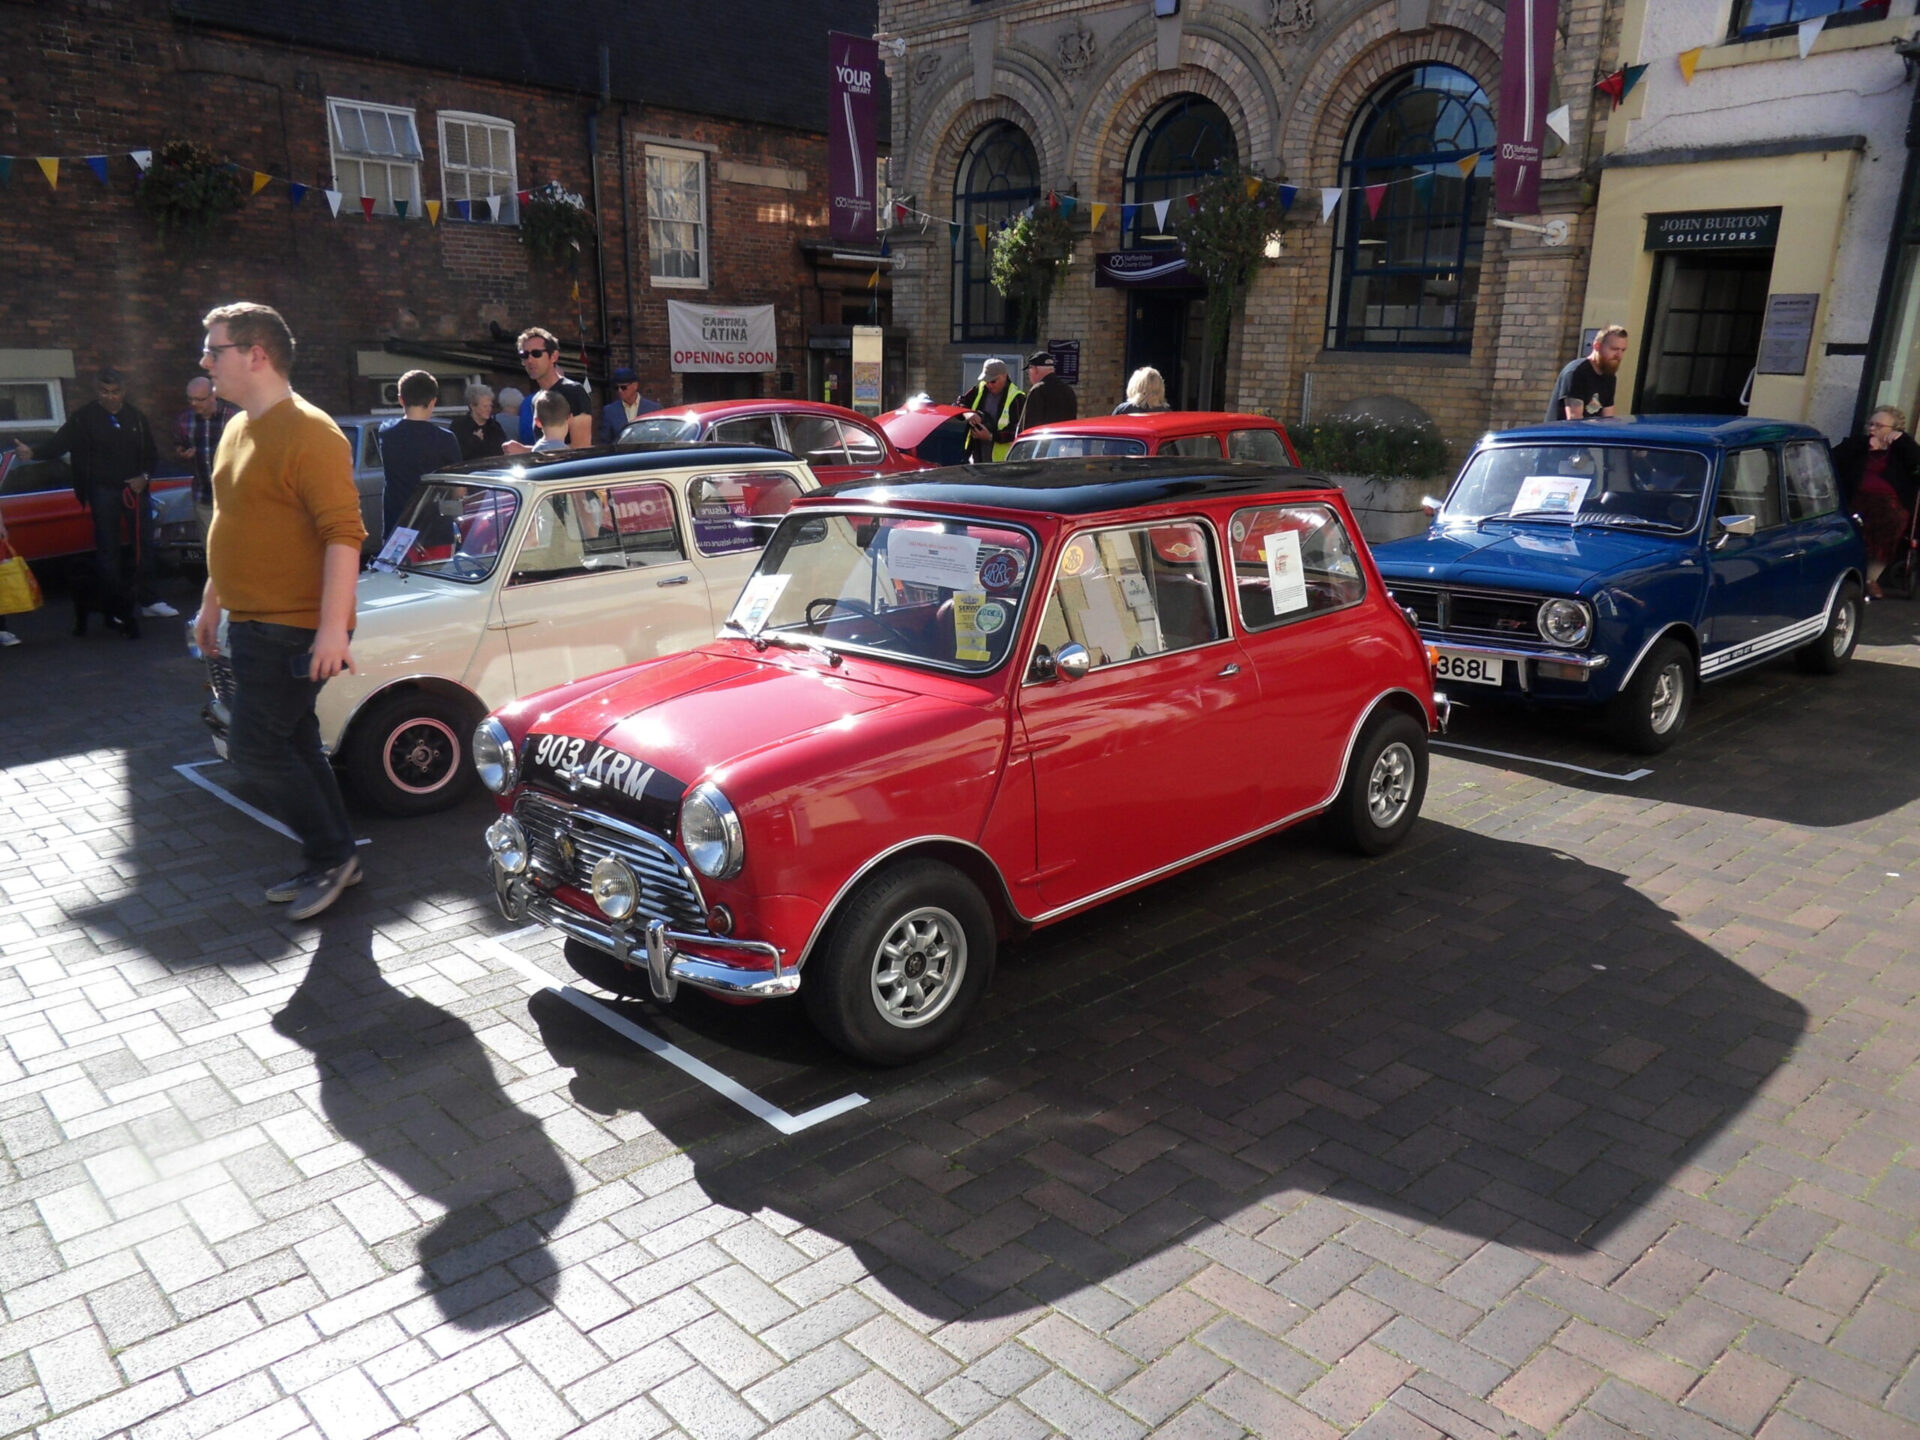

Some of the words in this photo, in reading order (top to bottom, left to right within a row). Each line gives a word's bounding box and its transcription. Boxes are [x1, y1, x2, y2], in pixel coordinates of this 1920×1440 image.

[836, 66, 871, 88] YOUR
[848, 85, 871, 95] LIBRARY
[1660, 219, 1701, 231] JOHN
[1704, 216, 1769, 230] BURTON
[1668, 232, 1757, 243] SOLICITORS
[702, 317, 748, 327] CANTINA
[702, 328, 748, 341] LATINA
[674, 351, 734, 365] OPENING
[738, 352, 774, 364] SOON
[1437, 655, 1497, 682] 368L
[535, 734, 586, 770] 903
[586, 745, 656, 801] KRM
